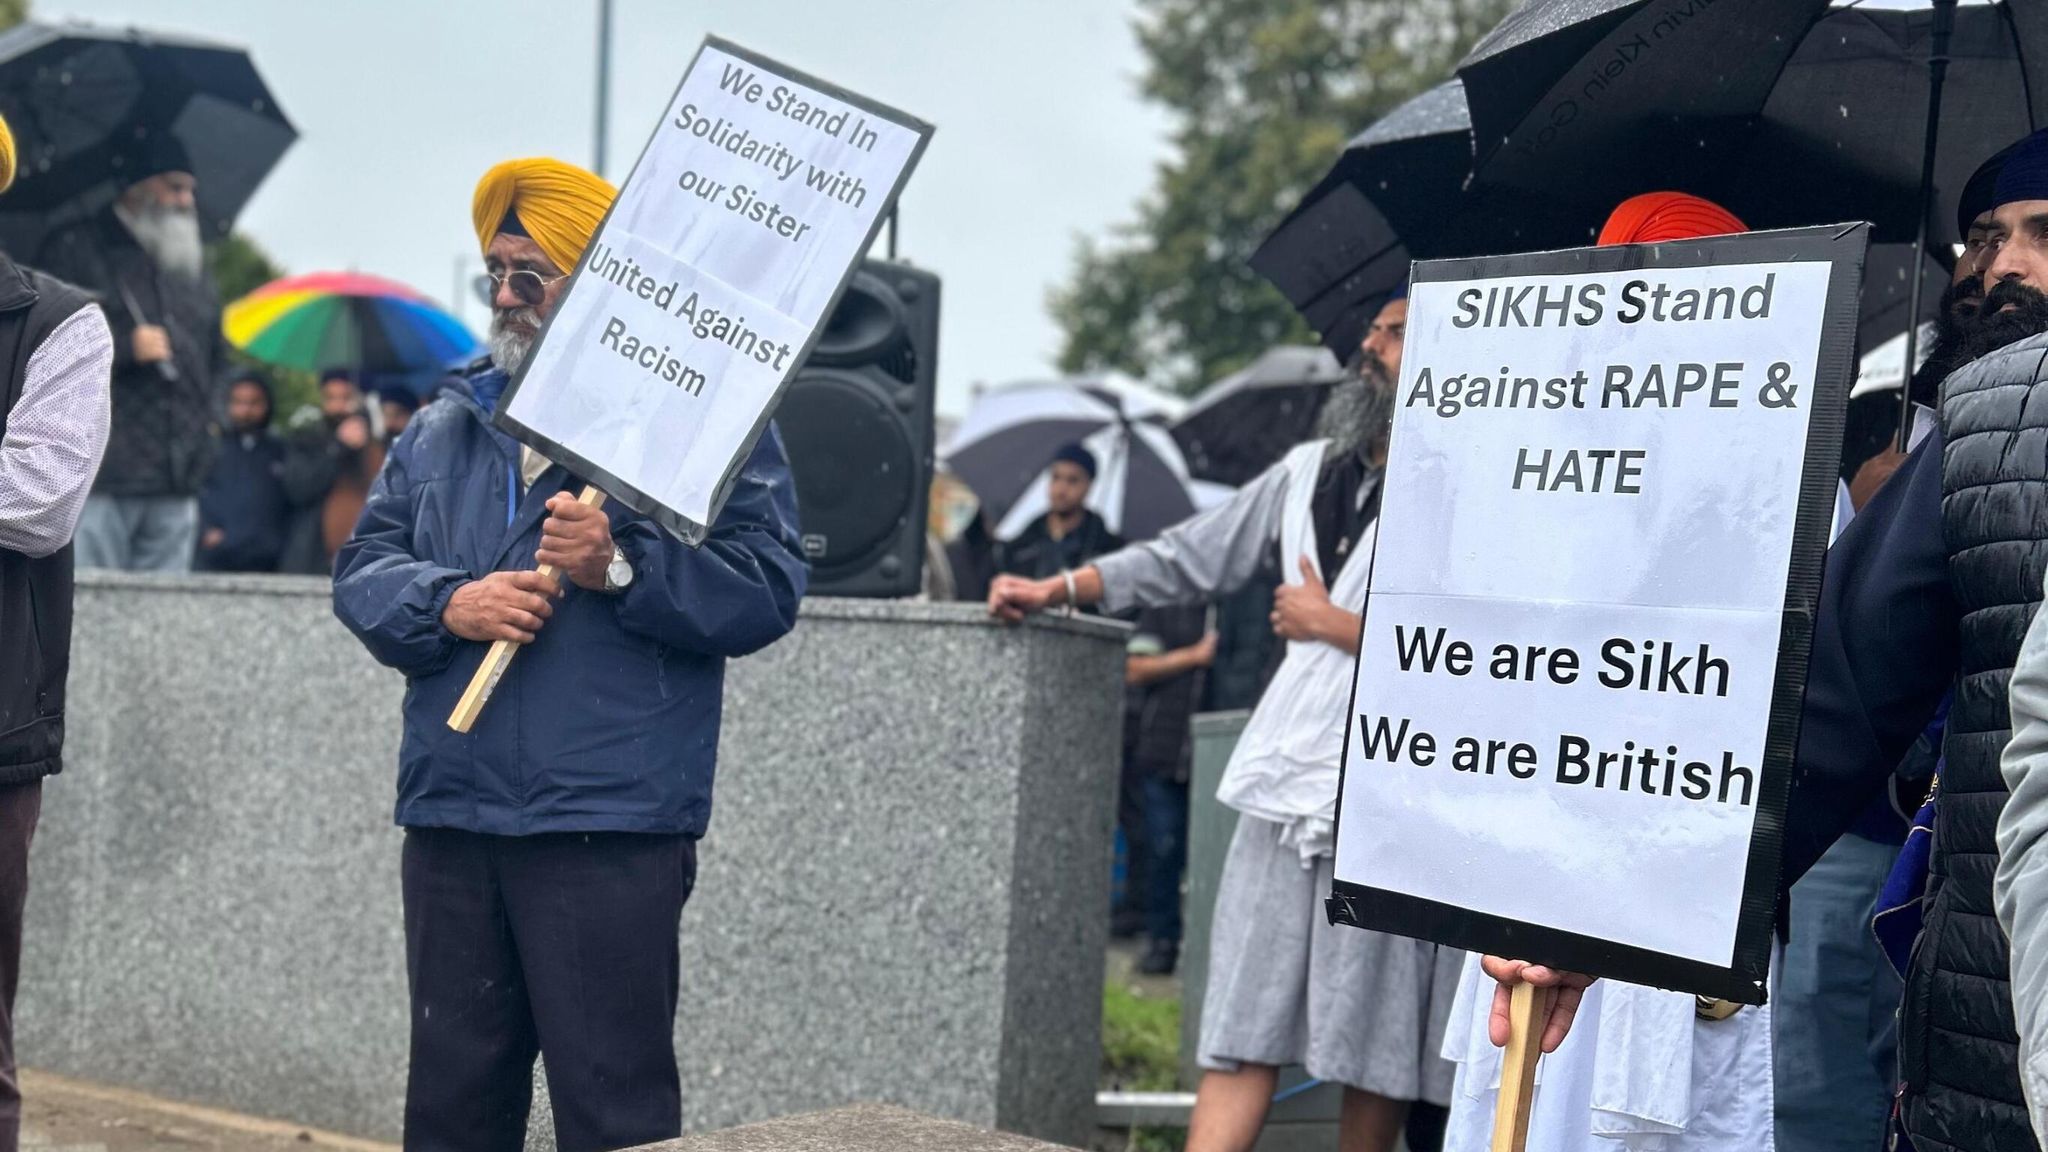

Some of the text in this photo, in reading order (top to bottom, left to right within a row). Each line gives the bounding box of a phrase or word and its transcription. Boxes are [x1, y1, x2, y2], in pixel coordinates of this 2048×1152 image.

[719, 63, 878, 152] We Stand In
[674, 103, 867, 209] Solidarity with
[678, 170, 811, 242] our Sister
[589, 243, 790, 372] United Against
[1452, 272, 1776, 329] SIKHS Stand
[599, 316, 706, 398] Racism
[1405, 361, 1798, 419] Against RAPE &
[1511, 448, 1646, 494] HATE
[1395, 624, 1730, 697] We are Sikh
[1359, 713, 1754, 806] We are British
